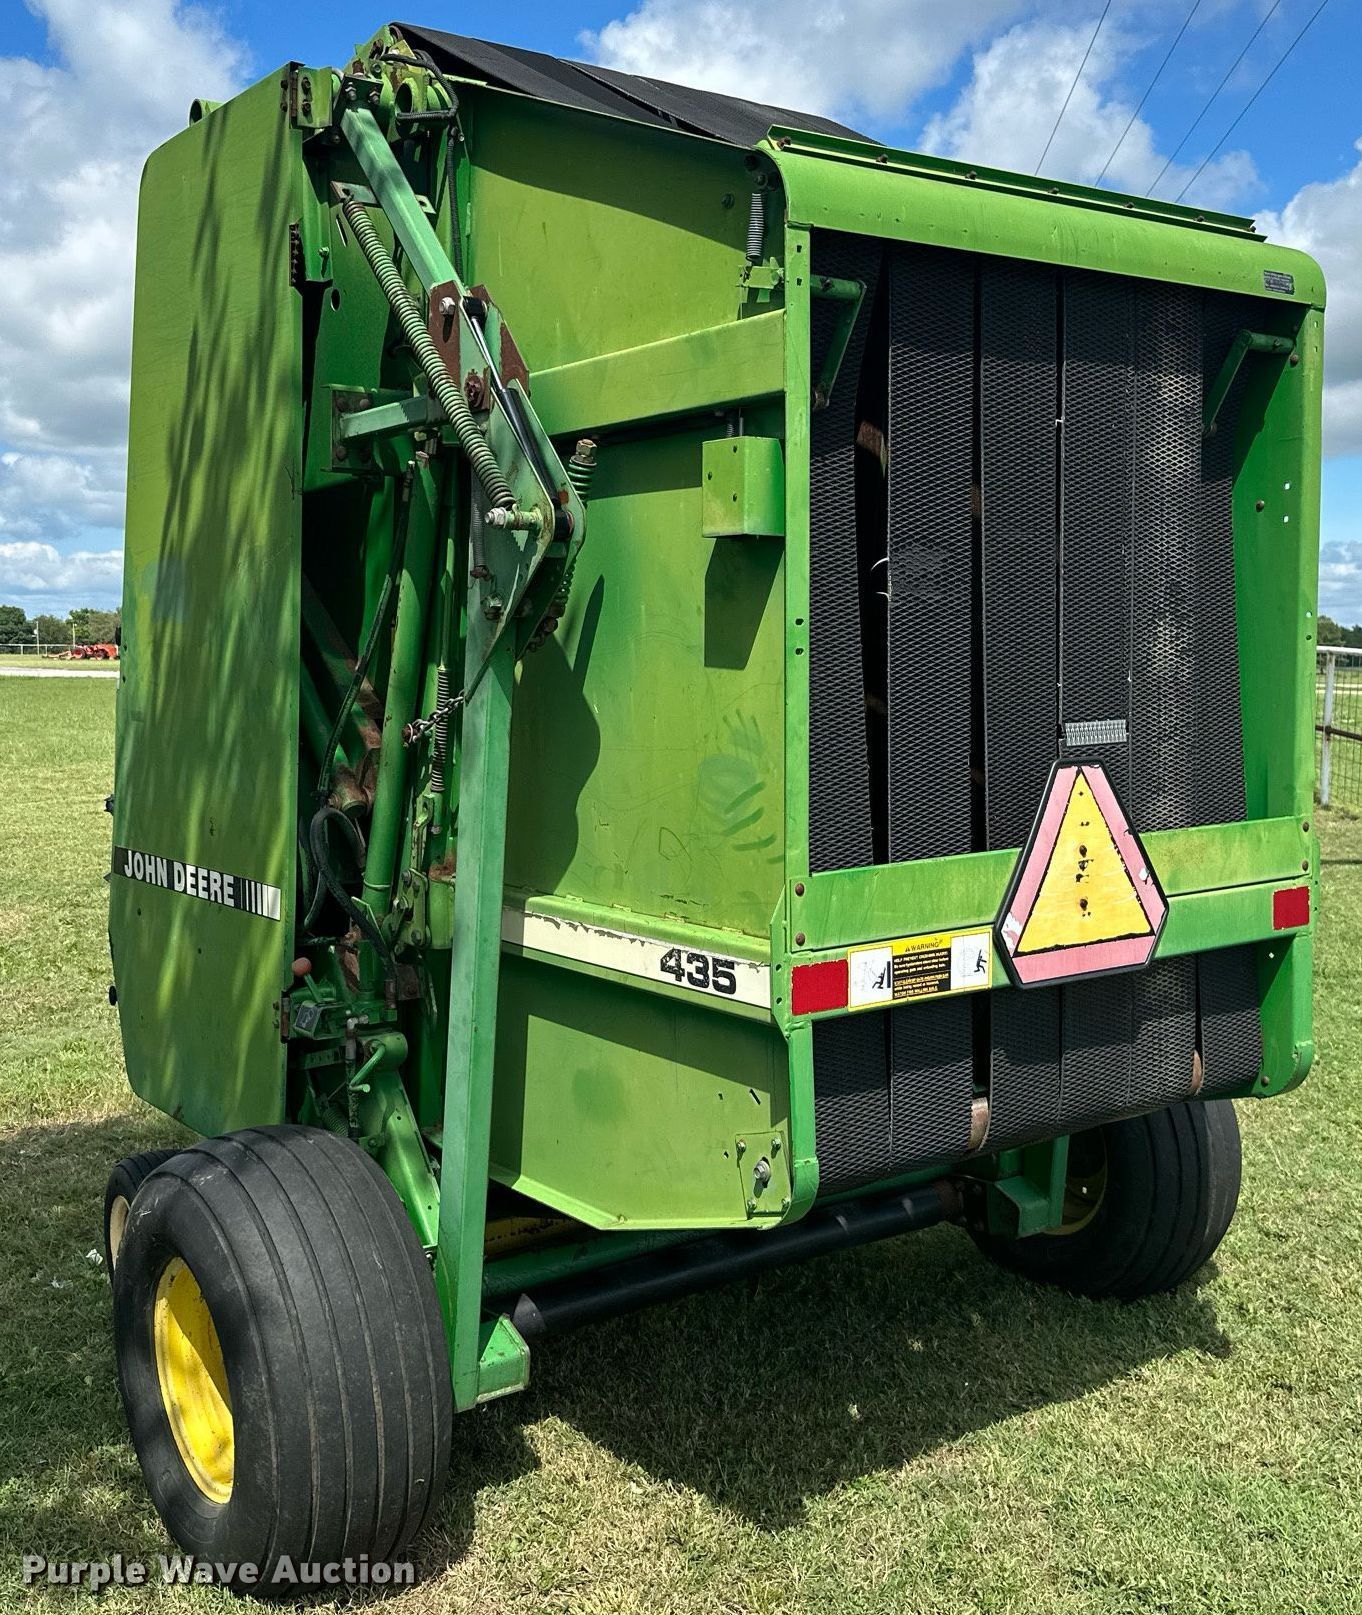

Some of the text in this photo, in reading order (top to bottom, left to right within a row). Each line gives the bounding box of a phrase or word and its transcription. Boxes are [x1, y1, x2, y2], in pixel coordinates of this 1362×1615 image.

[124, 850, 235, 907] JOHN DEERE
[910, 941, 940, 951] WARNING
[660, 947, 737, 995] 435
